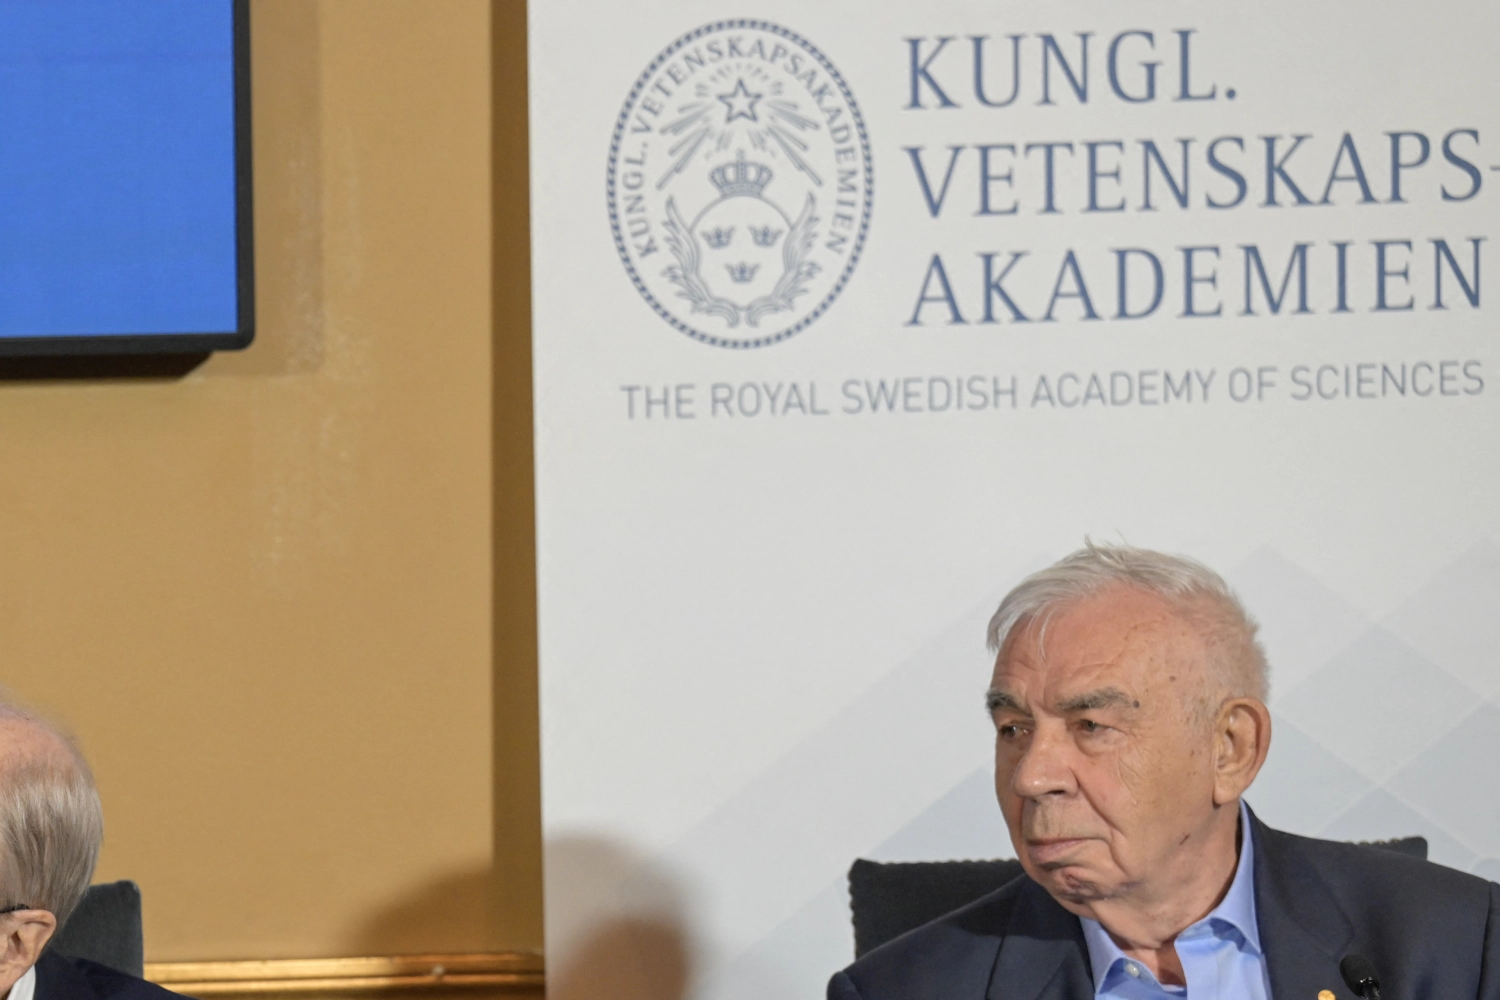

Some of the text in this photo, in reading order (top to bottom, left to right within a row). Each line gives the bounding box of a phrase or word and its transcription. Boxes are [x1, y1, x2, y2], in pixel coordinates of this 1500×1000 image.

[902, 29, 1238, 111] KUNGL.
[622, 35, 859, 259] KUNGL. VETENSKAPSAKADEMIEN
[904, 236, 1488, 328] AKADEMIEN
[619, 359, 1485, 421] THE ROYAL SWEDISH ACADEMY OF SCIENCES
